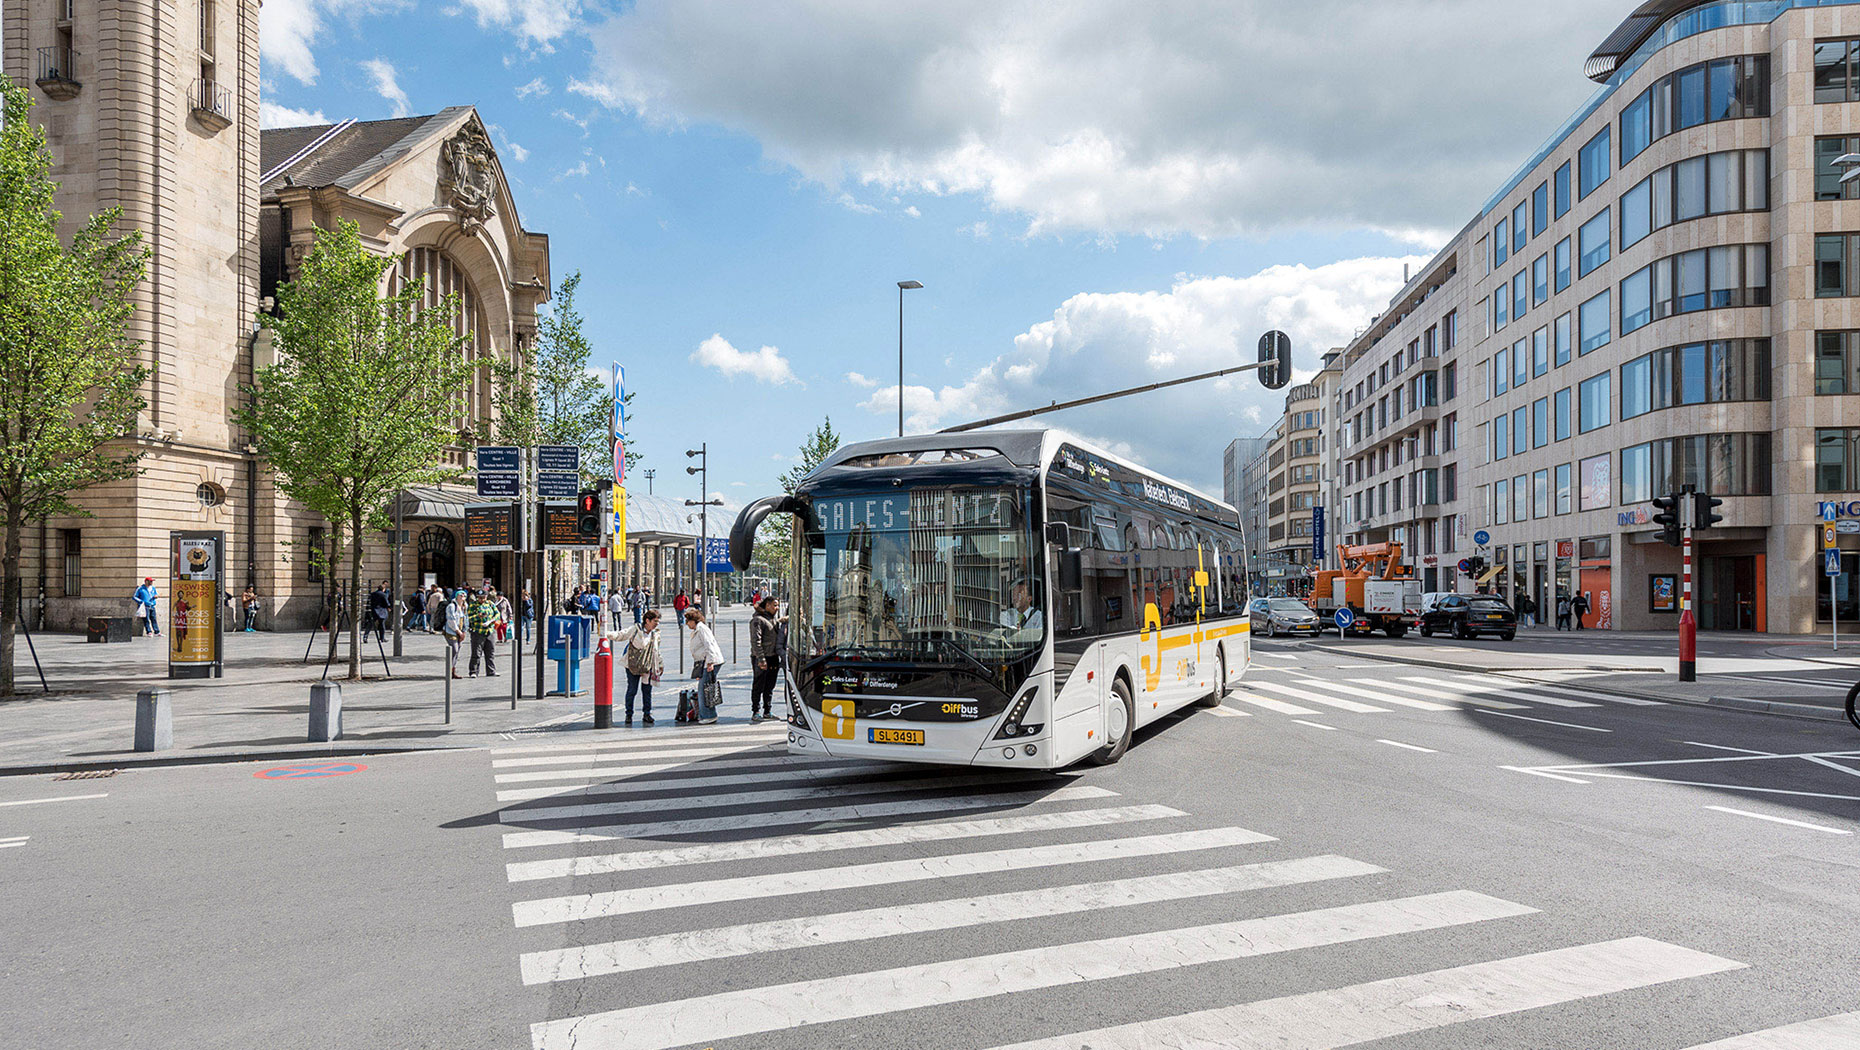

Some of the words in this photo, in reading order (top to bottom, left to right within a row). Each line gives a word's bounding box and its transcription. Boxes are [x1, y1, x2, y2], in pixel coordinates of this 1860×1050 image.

[1617, 511, 1635, 526] ING
[831, 704, 844, 734] 1
[879, 731, 891, 741] SL
[893, 731, 917, 742] 3491
